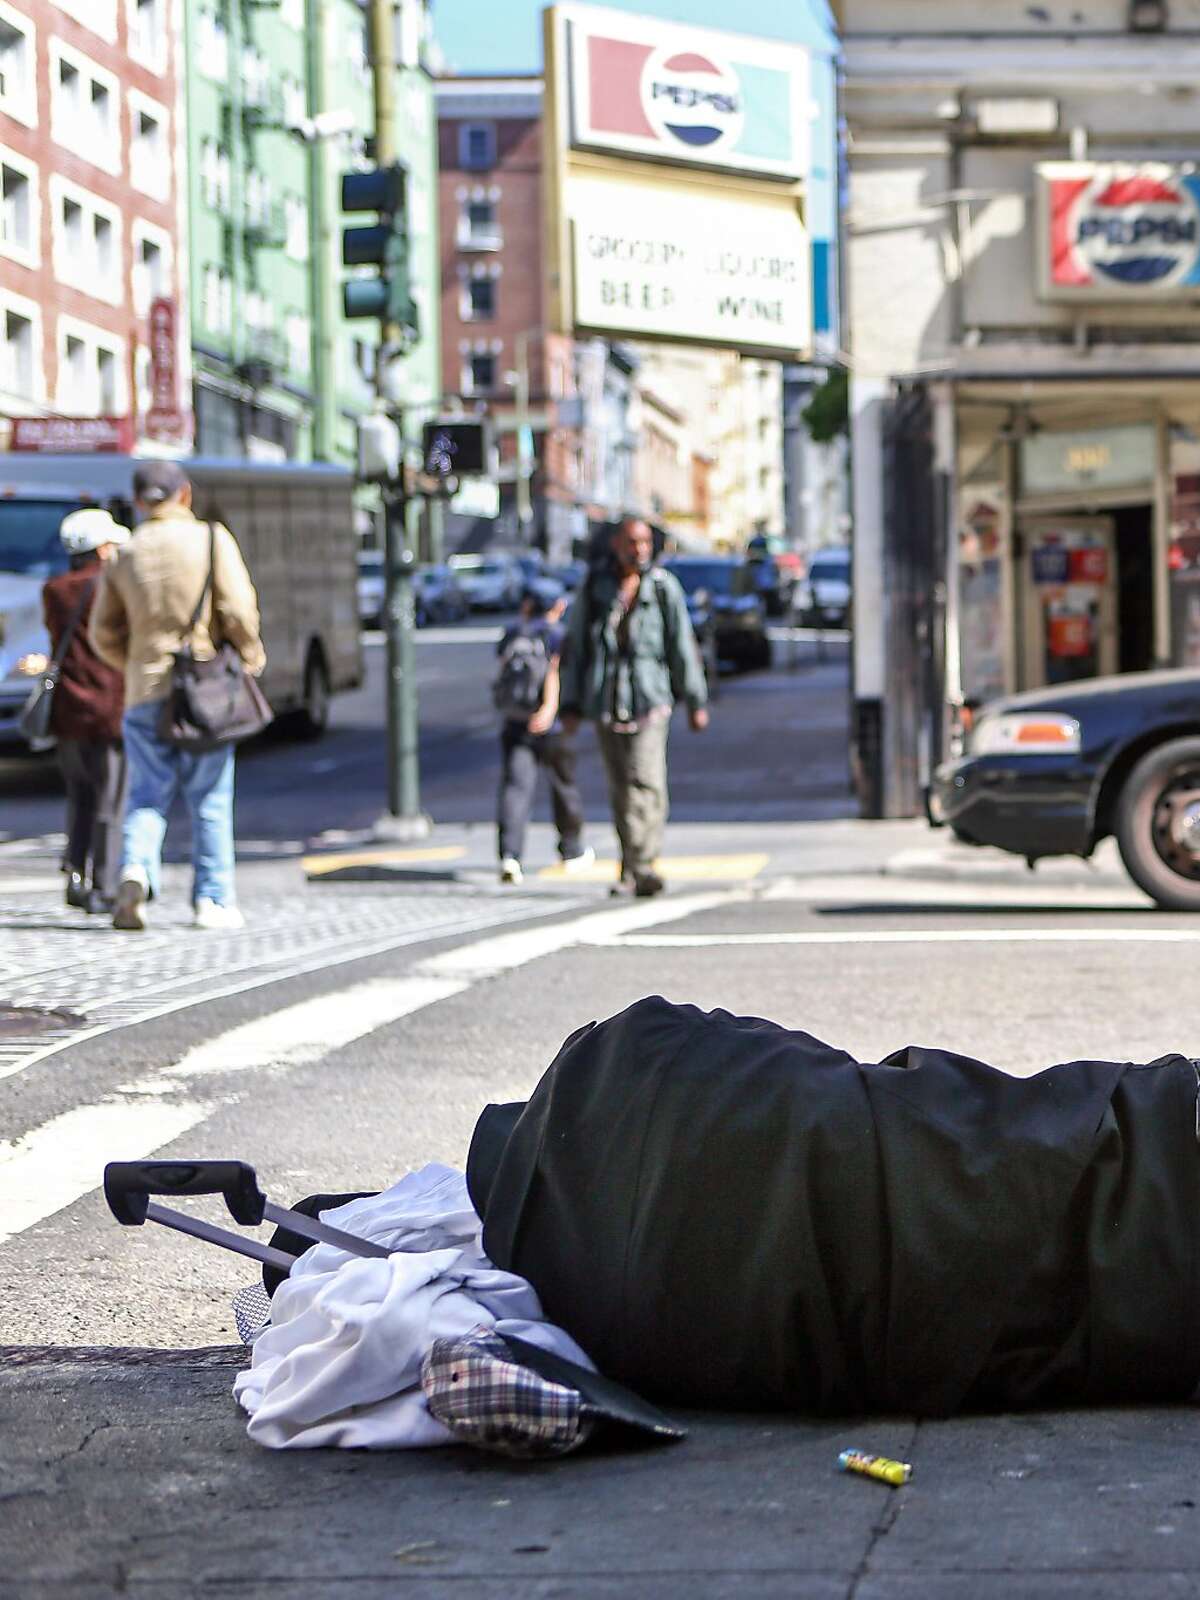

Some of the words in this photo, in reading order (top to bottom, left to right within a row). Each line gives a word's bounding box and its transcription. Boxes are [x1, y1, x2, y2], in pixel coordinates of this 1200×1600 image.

[652, 81, 737, 112] PEPSI
[1078, 217, 1197, 244] PEPSI
[601, 278, 677, 312] BEER
[717, 296, 784, 326] WINE
